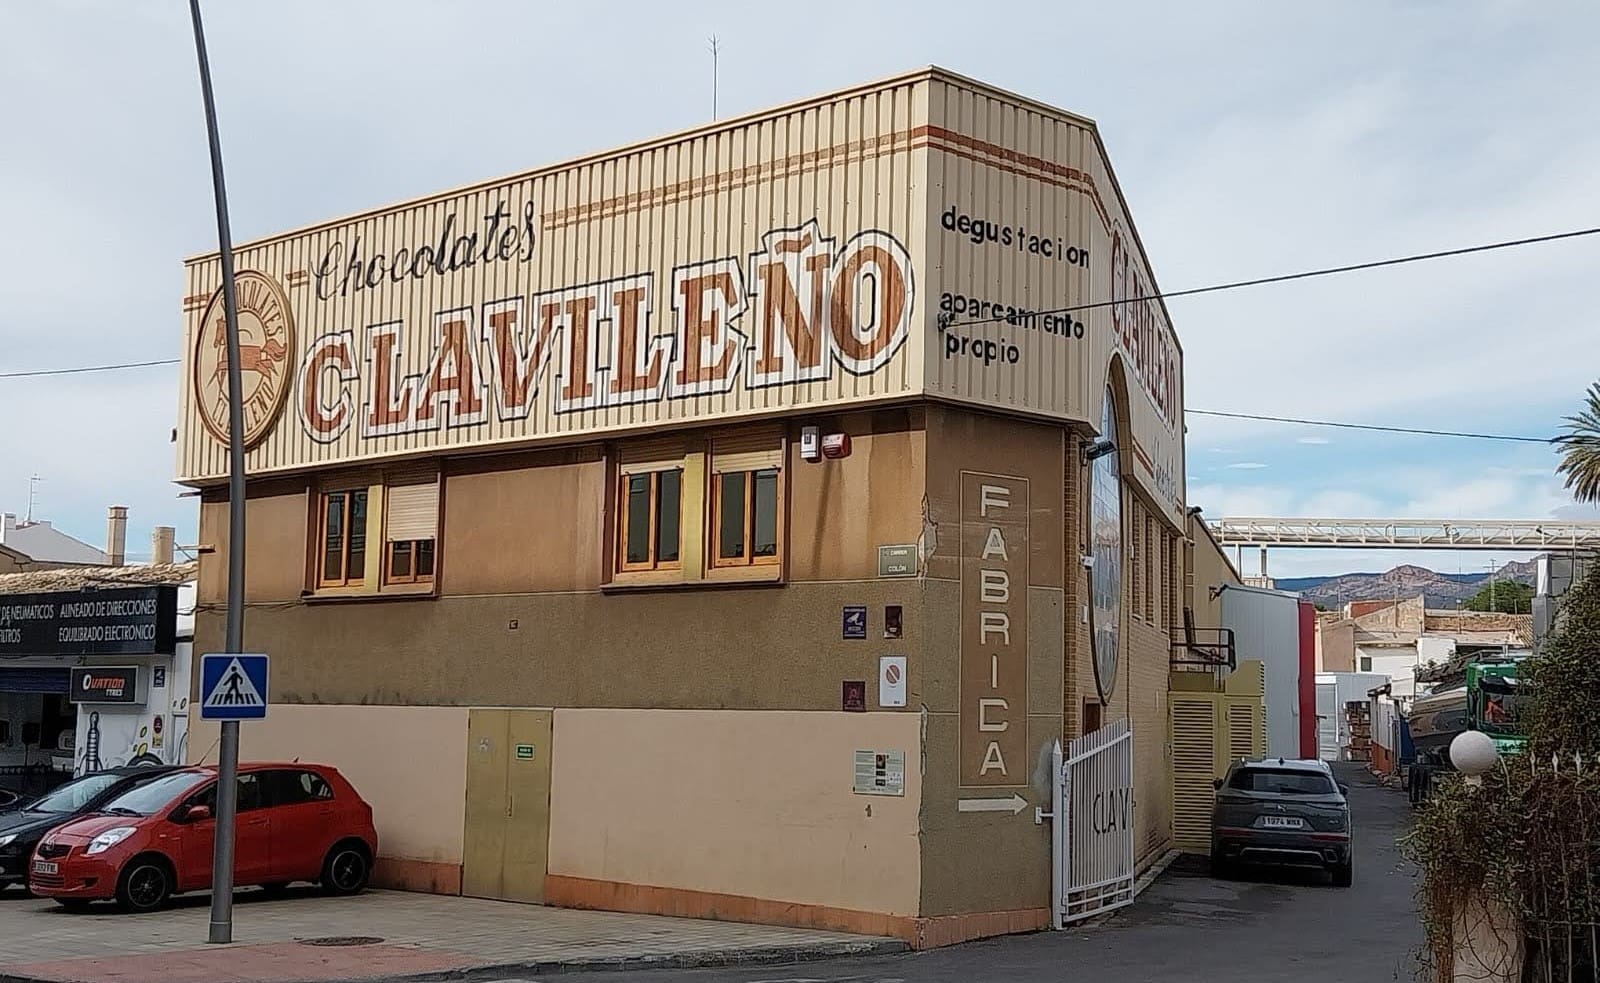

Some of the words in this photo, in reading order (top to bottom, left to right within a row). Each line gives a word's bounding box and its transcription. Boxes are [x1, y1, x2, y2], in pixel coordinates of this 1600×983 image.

[311, 200, 536, 300] Chocolates
[941, 205, 1090, 268] degustacion
[298, 217, 914, 445] CLAVILEÑO
[945, 332, 1020, 366] propio
[11, 604, 54, 620] NEUMATICOS
[60, 601, 95, 618] ALINEADO
[96, 601, 105, 617] DE
[107, 599, 157, 616] DIRECCIONES
[978, 484, 1010, 776] FABRICA
[59, 626, 104, 642] EQUILIBRADO
[105, 624, 156, 641] ELECTRONICO
